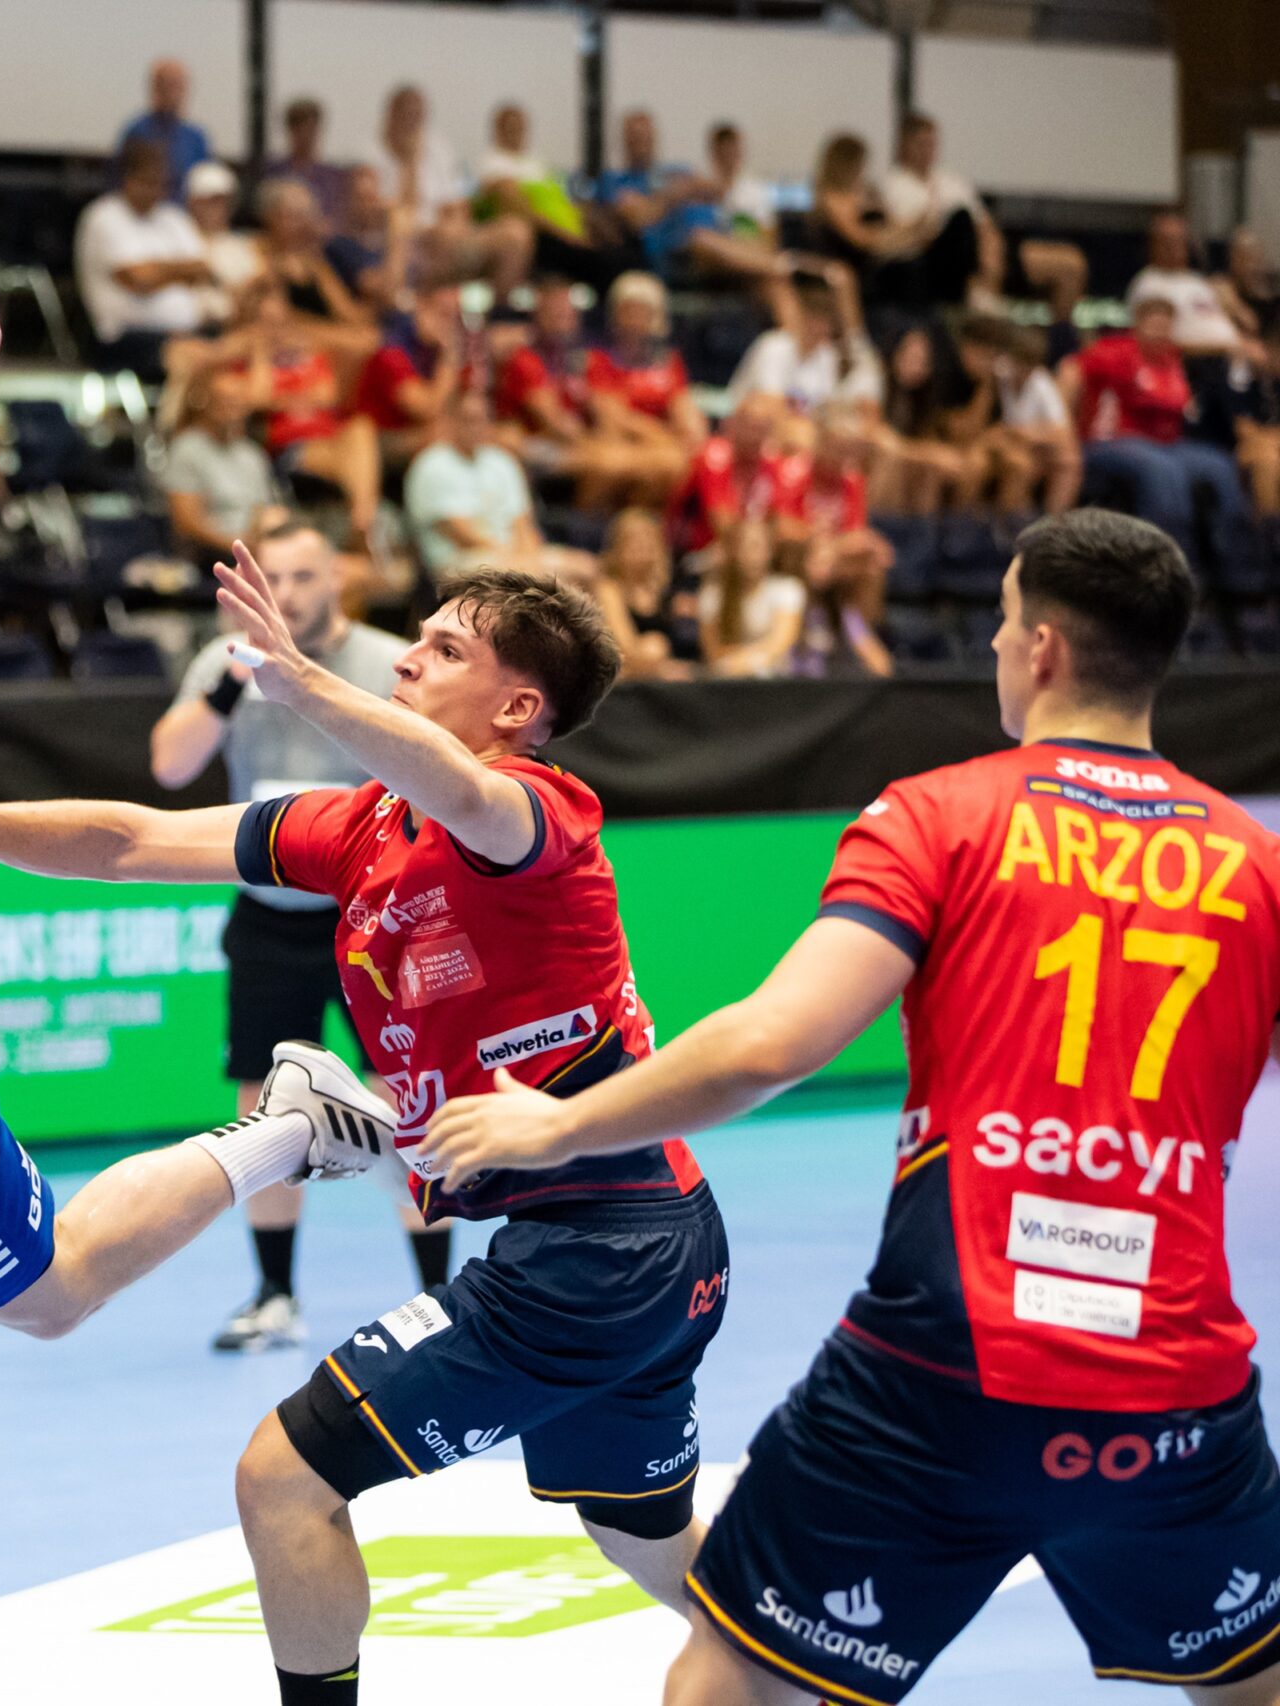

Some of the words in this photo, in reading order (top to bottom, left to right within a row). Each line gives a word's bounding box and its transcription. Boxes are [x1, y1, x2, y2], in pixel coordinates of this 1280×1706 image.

[997, 802, 1247, 922] ARZOZ
[479, 1028, 565, 1064] helvetia
[1034, 912, 1220, 1101] 17
[972, 1111, 1206, 1196] sacyr
[1018, 1217, 1146, 1256] VARGROUP
[755, 1585, 920, 1682] Santander
